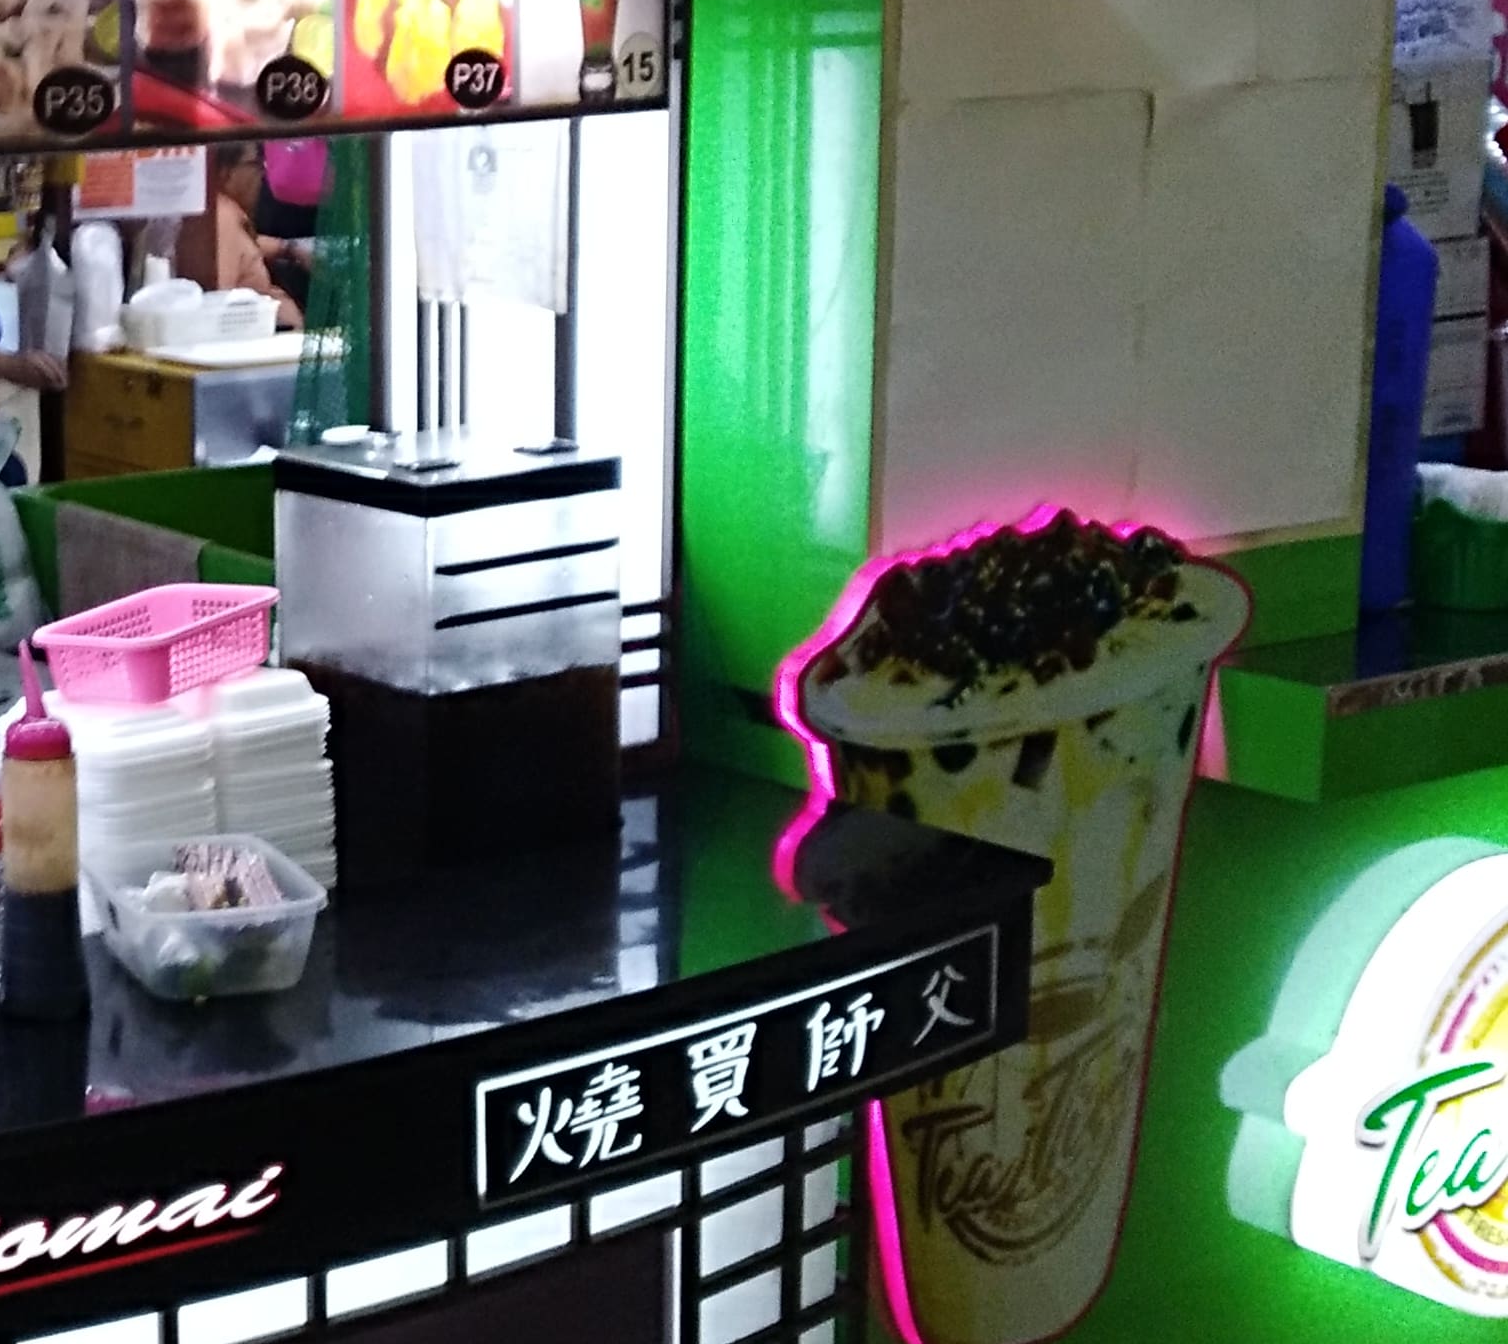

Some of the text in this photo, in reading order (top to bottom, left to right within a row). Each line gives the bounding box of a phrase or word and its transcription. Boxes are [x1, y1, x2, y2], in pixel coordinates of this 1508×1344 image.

[453, 62, 499, 96] P37
[622, 51, 654, 84] 15
[44, 84, 105, 120] P35
[265, 72, 319, 103] P38
